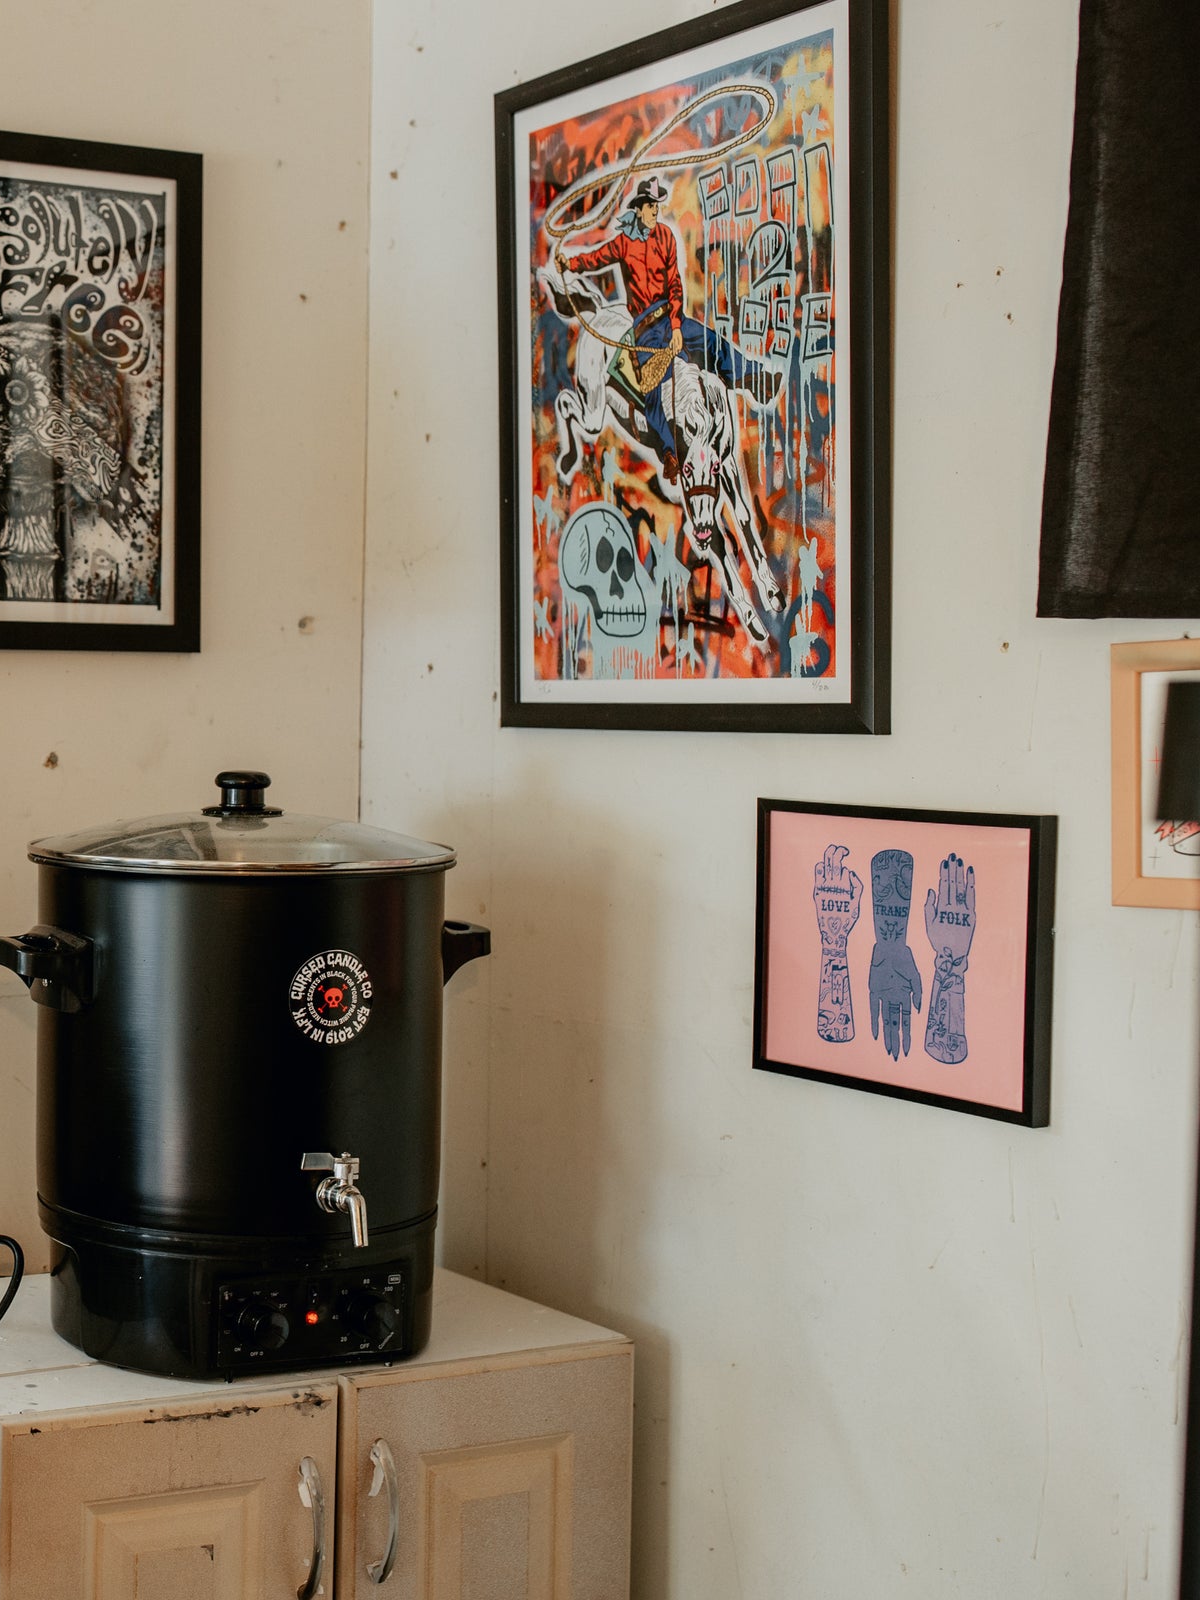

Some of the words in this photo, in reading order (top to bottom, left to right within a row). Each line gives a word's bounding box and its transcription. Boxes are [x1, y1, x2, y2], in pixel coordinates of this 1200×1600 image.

[749, 221, 790, 289] 2
[712, 273, 832, 362] LOSE
[821, 899, 850, 912] LOVE
[874, 904, 909, 918] TRANS
[939, 911, 971, 927] FOLK
[291, 956, 326, 1000] CURSED
[327, 953, 368, 984] CANDLE
[360, 981, 372, 999] CO
[326, 970, 346, 979] BLACK
[352, 1006, 370, 1032] EST
[310, 1028, 325, 1043] IN
[326, 1026, 354, 1044] 2019
